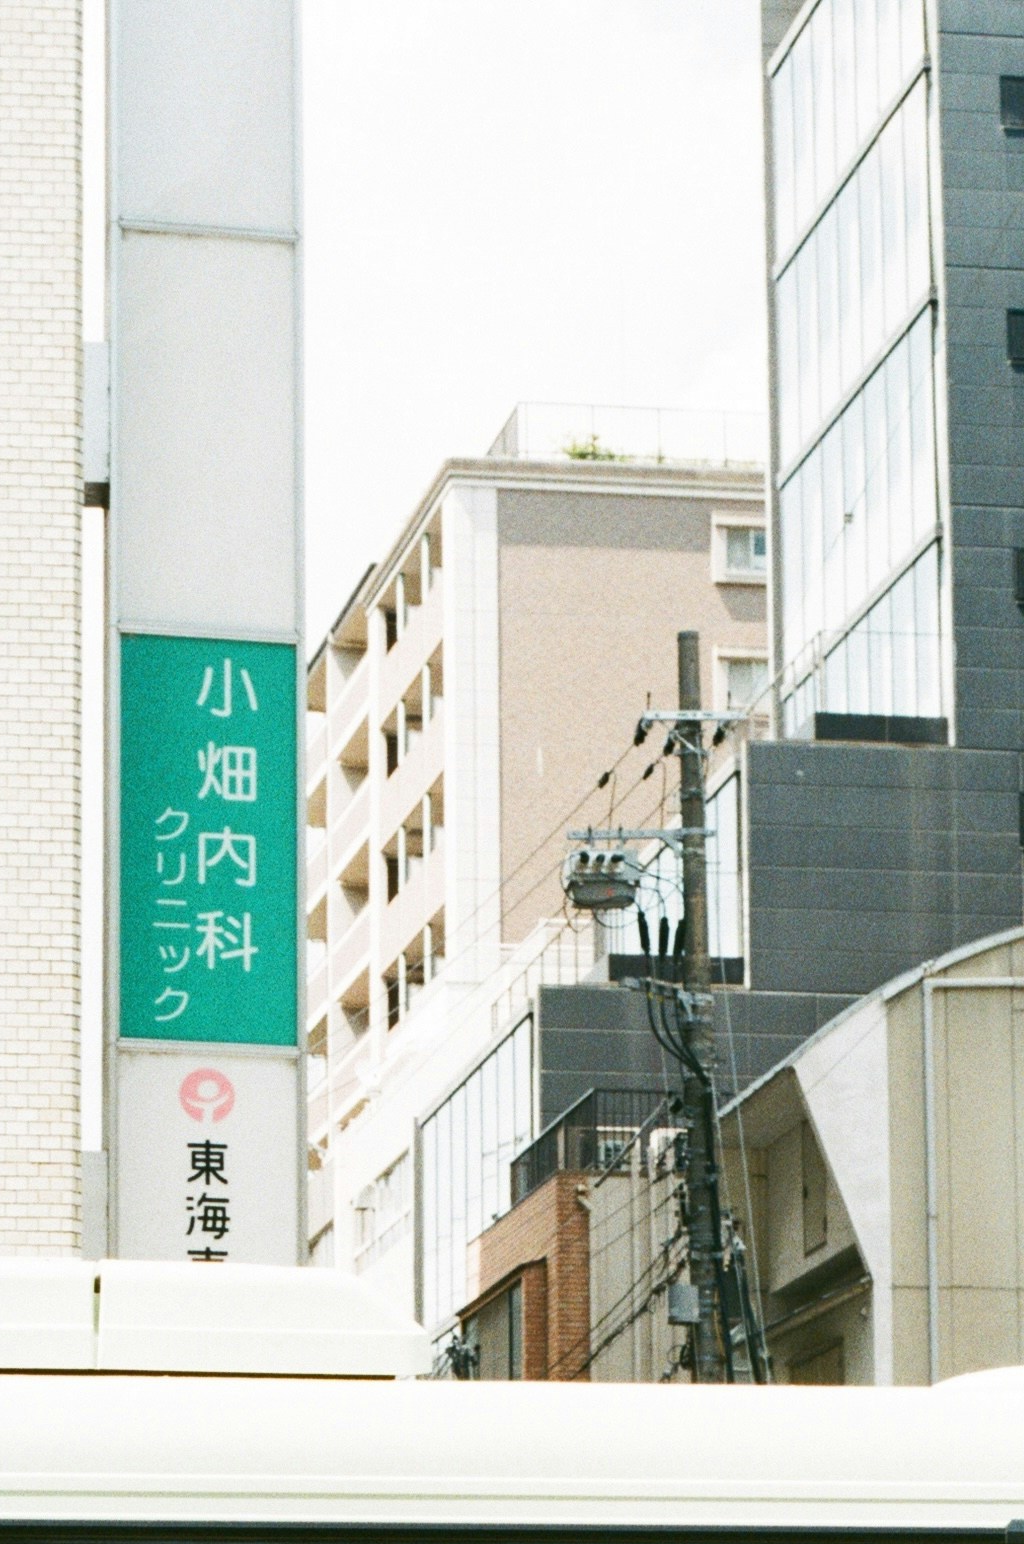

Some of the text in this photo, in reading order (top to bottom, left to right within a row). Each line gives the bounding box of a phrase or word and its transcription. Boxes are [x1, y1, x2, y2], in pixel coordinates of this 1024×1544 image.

[152, 806, 191, 1022] クリニック
[195, 658, 259, 973] 小畑内科
[186, 1139, 230, 1262] 東海
